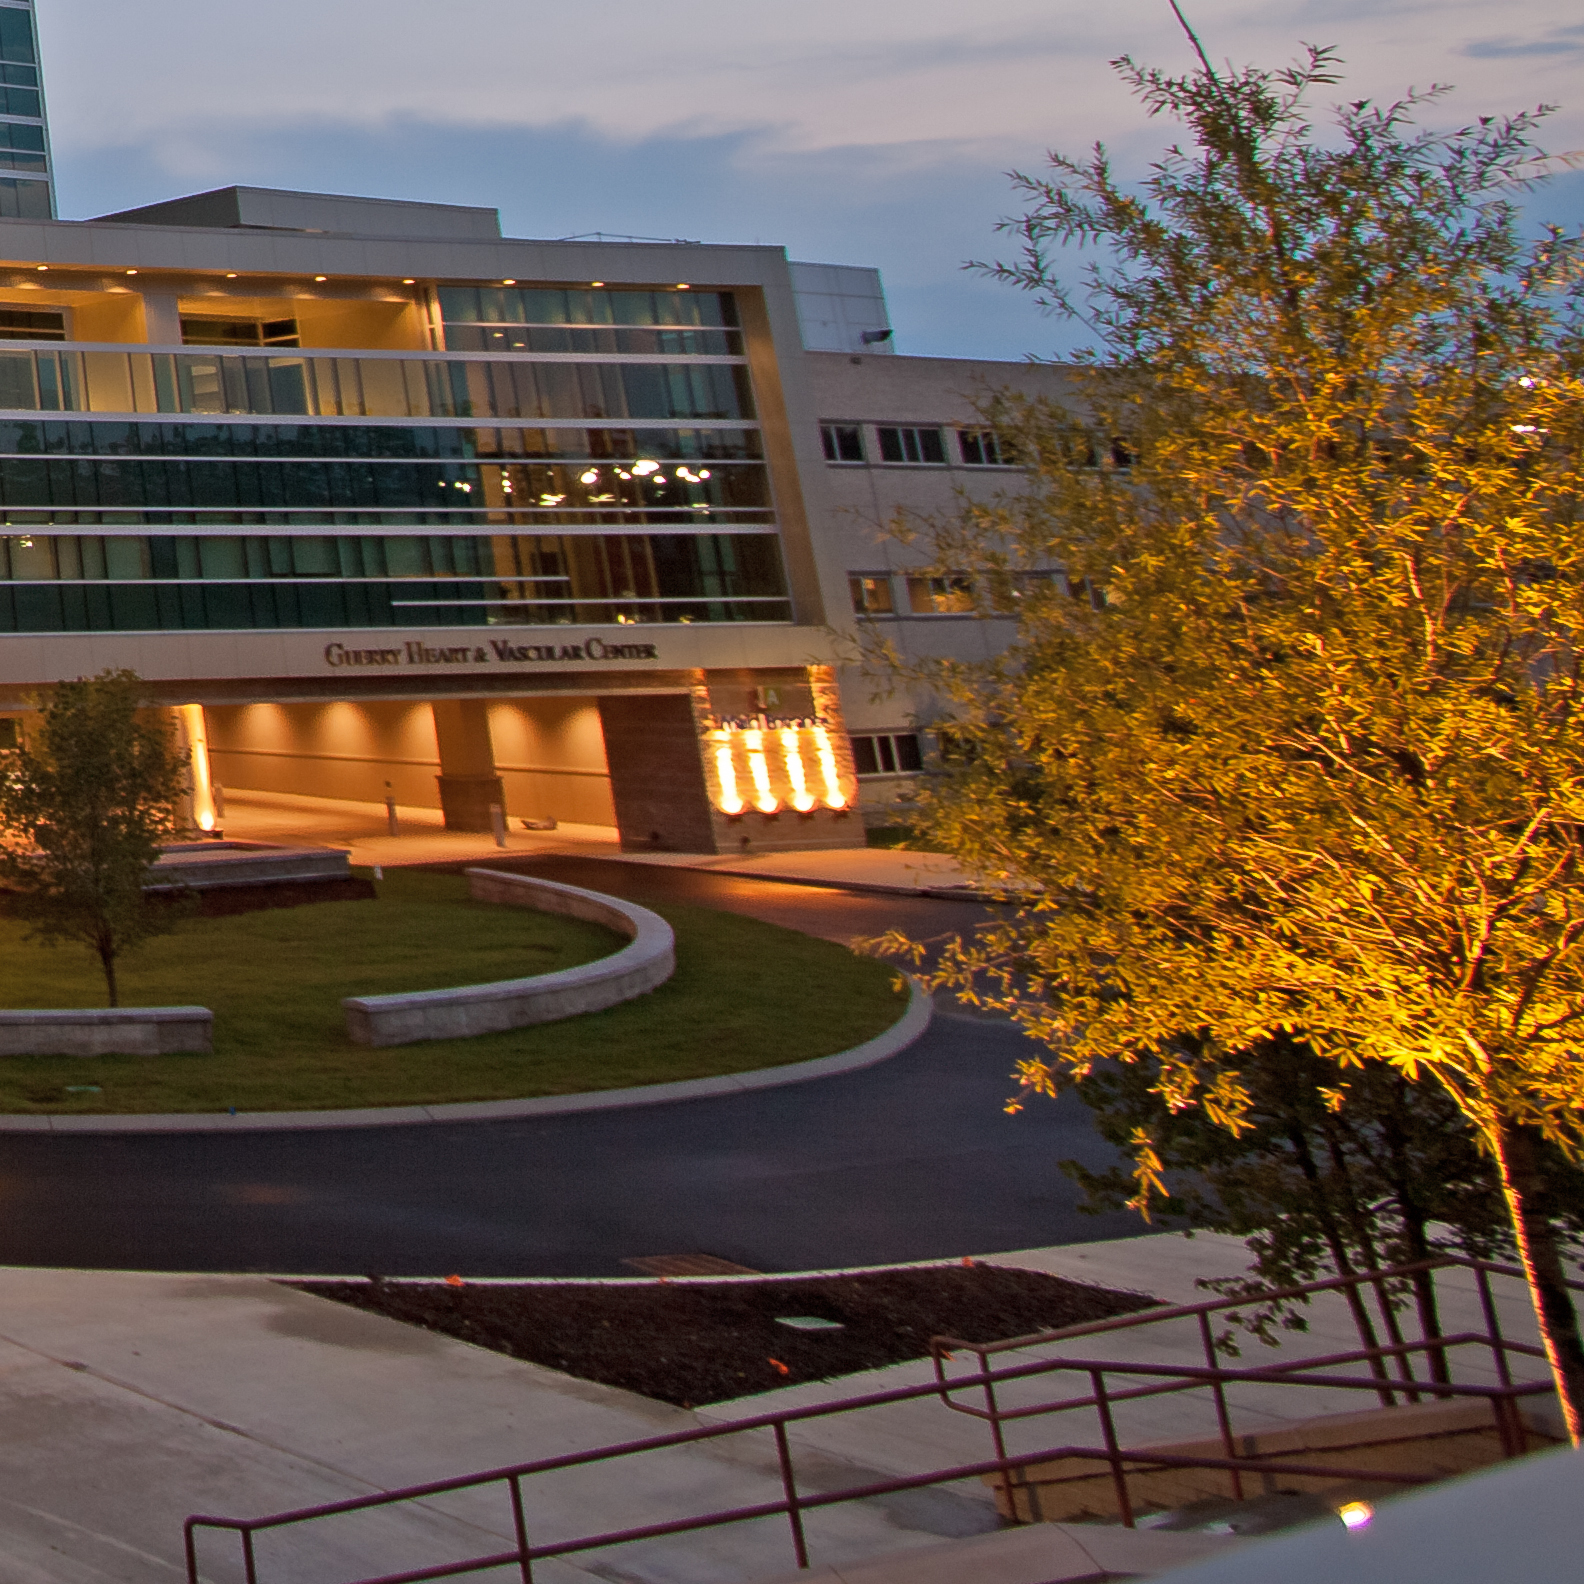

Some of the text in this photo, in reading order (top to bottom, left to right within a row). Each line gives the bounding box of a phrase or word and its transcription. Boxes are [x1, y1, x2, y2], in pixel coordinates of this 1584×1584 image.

[325, 637, 658, 666] GUERRY HEART & VASCULAR CENTER
